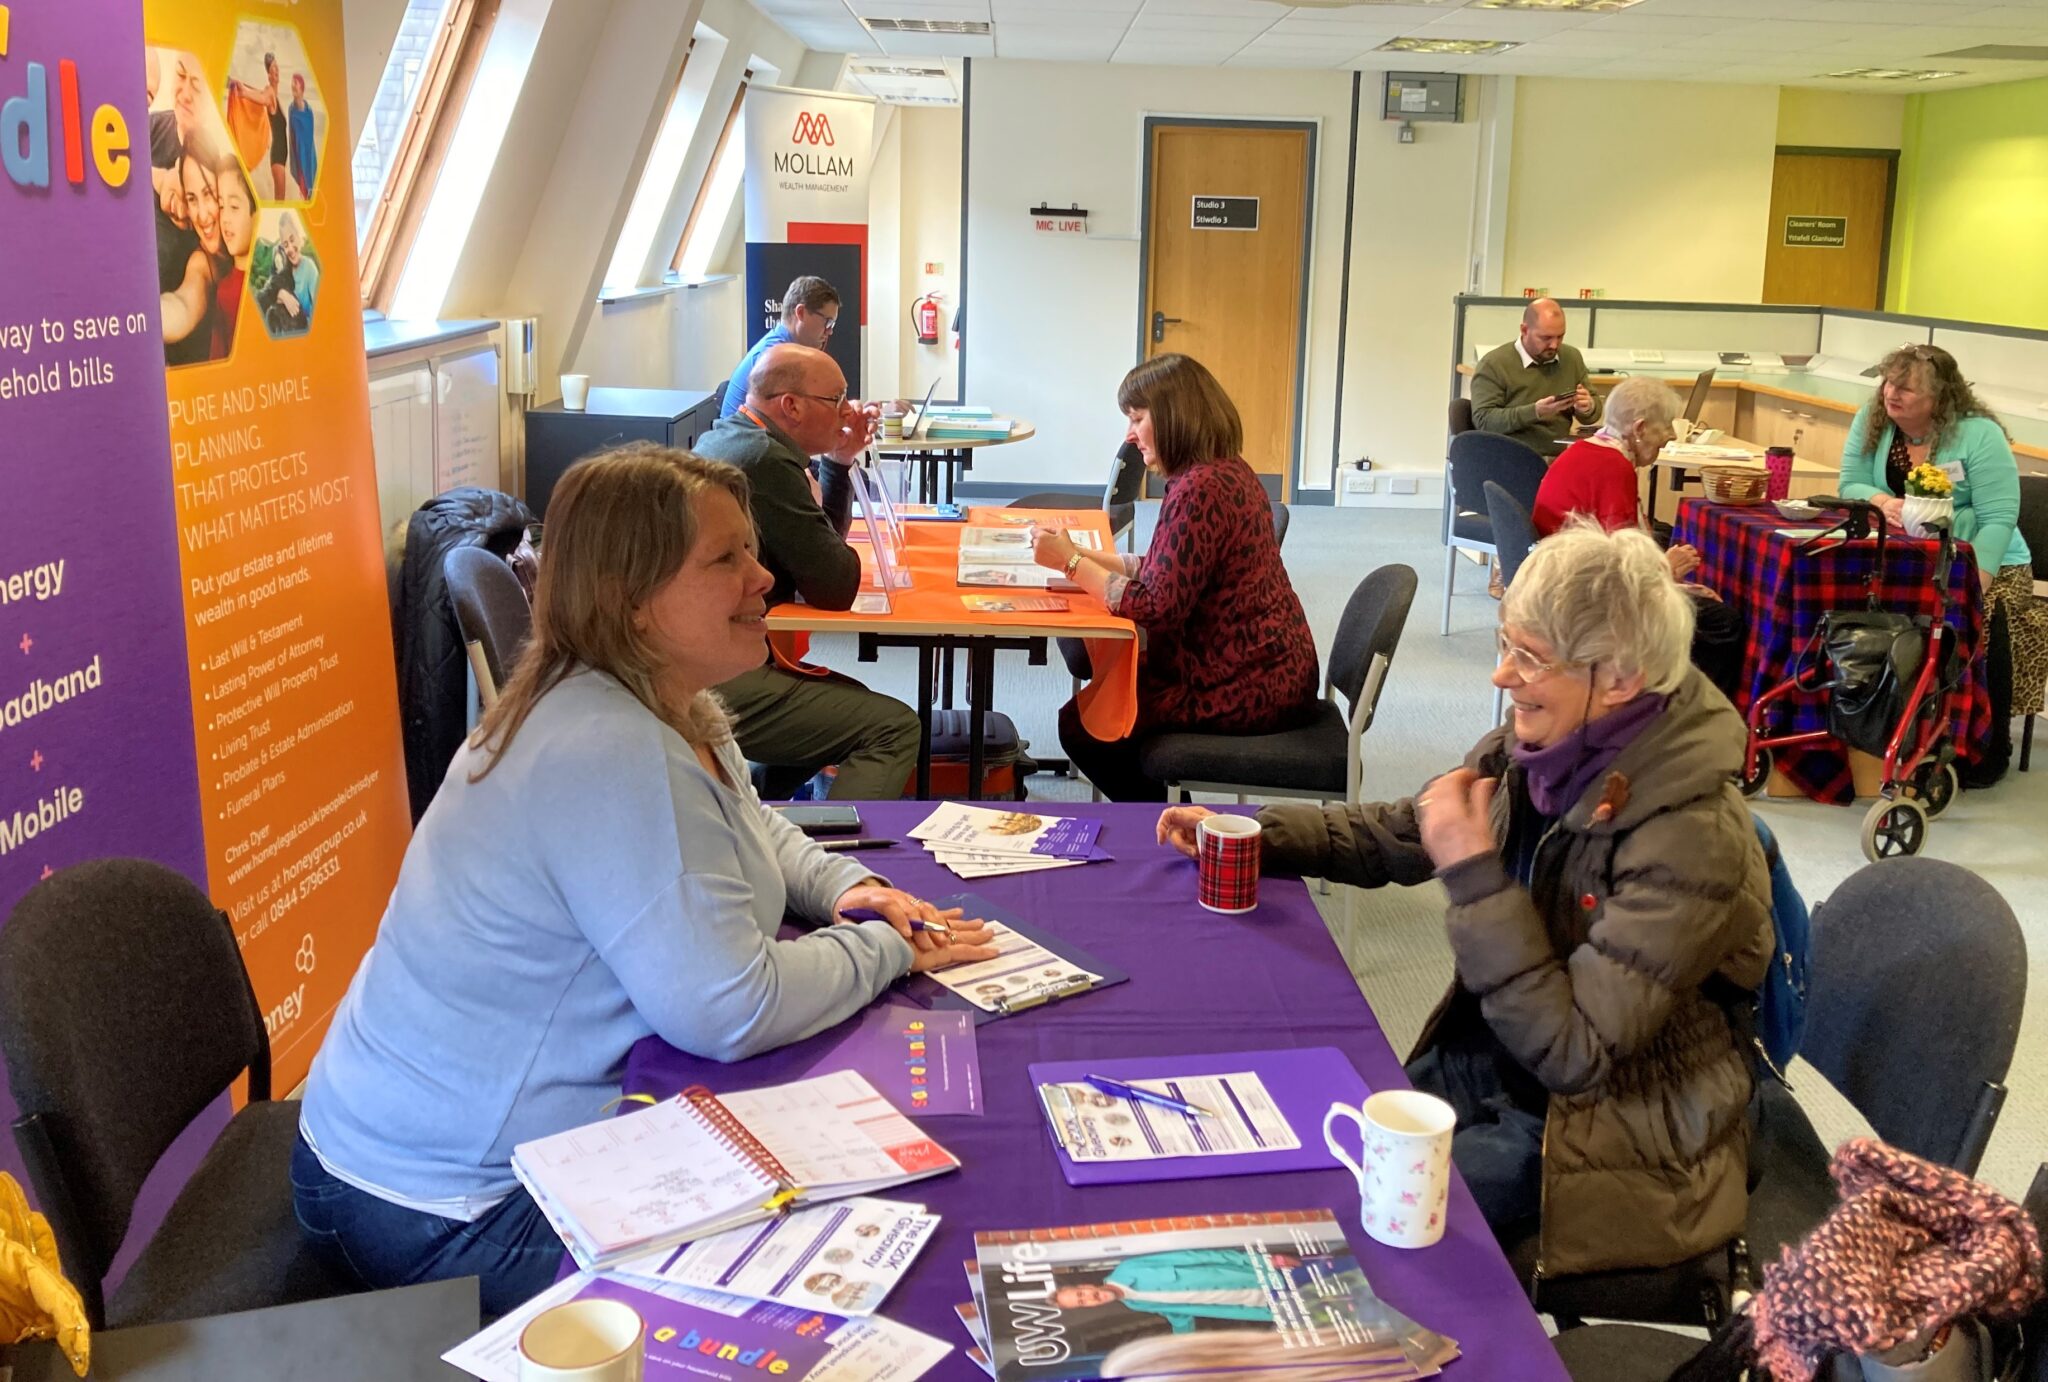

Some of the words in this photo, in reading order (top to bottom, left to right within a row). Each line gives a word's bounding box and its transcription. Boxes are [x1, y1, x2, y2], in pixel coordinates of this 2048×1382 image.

[774, 151, 853, 177] MOLLAM
[779, 181, 804, 190] WEALTH
[805, 183, 848, 193] MANAGEMENT
[1036, 220, 1054, 231] MIC
[1058, 220, 1081, 232] LIVE
[1196, 201, 1219, 209] Studio
[1220, 201, 1226, 209] 3
[41, 318, 65, 343] to
[73, 316, 120, 340] save
[126, 312, 147, 334] on
[0, 361, 60, 399] ehold
[69, 356, 114, 388] bills
[168, 394, 218, 428] PURE
[222, 387, 255, 417] AND
[258, 376, 312, 409] SIMPLE
[174, 425, 264, 470] PLANNING.
[177, 474, 225, 511] THAT
[229, 451, 308, 496] PROTECTS
[184, 512, 235, 552] WHAT
[239, 490, 306, 534] MATTERS
[308, 476, 353, 509] MOST.
[191, 575, 215, 598] Put
[215, 566, 241, 594] your
[242, 554, 274, 577] estate
[275, 542, 295, 565] and
[297, 531, 334, 556] lifetime
[194, 596, 235, 627] wealth
[237, 592, 248, 609] in
[249, 577, 277, 609] good
[278, 565, 311, 592] hands.
[208, 649, 230, 671] Last
[230, 638, 249, 660] Will
[249, 634, 256, 650] &
[257, 613, 304, 645] Testament
[212, 672, 247, 700] Lasting
[248, 657, 276, 682] Power
[277, 647, 287, 666] of
[288, 634, 325, 661] Attorney
[216, 695, 263, 730] Protective
[263, 681, 281, 702] Will
[281, 665, 318, 693] Property
[318, 652, 339, 672] Trust
[219, 734, 248, 760] Living
[248, 718, 271, 741] Trust
[223, 757, 259, 790] Probate
[260, 748, 268, 765] &
[269, 734, 295, 760] Estate
[297, 700, 354, 743] Administration
[226, 782, 261, 818] Funeral
[261, 770, 286, 794] Plans
[0, 786, 82, 855] Mobile
[225, 838, 249, 864] Chris
[249, 824, 270, 847] Dyer
[231, 893, 256, 923] Visit
[256, 886, 269, 905] us
[271, 873, 282, 894] at
[282, 809, 368, 885] honeygroup.co.uk
[249, 911, 269, 940] call
[270, 887, 298, 923] 0844
[299, 855, 342, 900] 5796331
[862, 1217, 913, 1268] Giveaway
[906, 1218, 932, 1239] The
[882, 1240, 915, 1270] £20K
[678, 1329, 789, 1375] bundle
